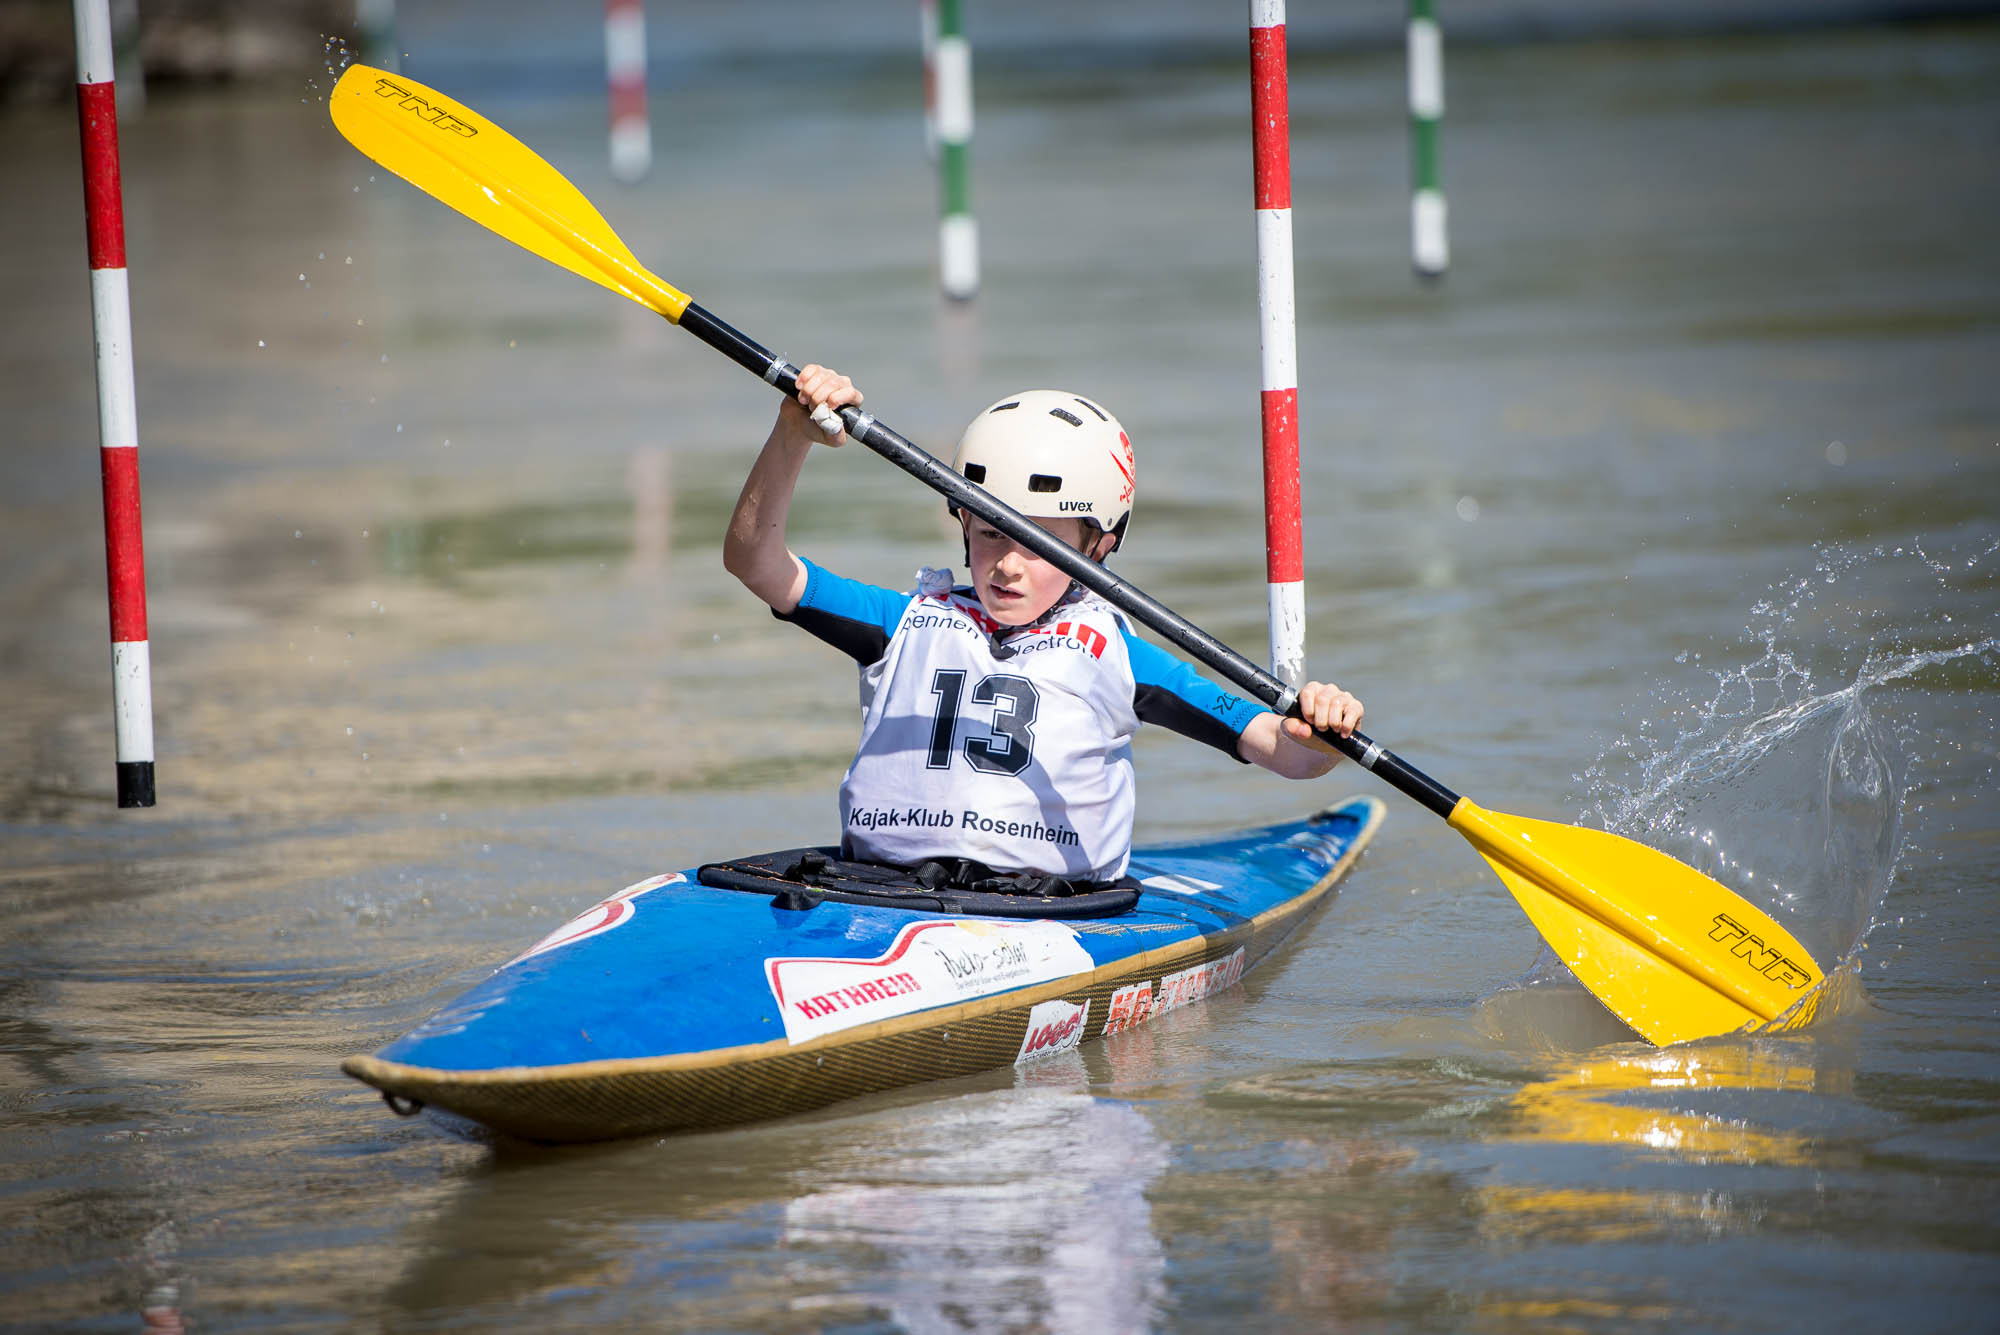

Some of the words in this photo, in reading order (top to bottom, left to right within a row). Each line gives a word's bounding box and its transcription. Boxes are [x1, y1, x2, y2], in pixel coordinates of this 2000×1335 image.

[375, 78, 478, 138] TNP
[1059, 500, 1093, 513] uvex
[926, 669, 1041, 778] 13
[849, 807, 954, 831] Kajak-Klub
[961, 810, 1079, 846] Rosenheim
[1708, 913, 1812, 989] TNP
[794, 972, 922, 1020] KATHREIN
